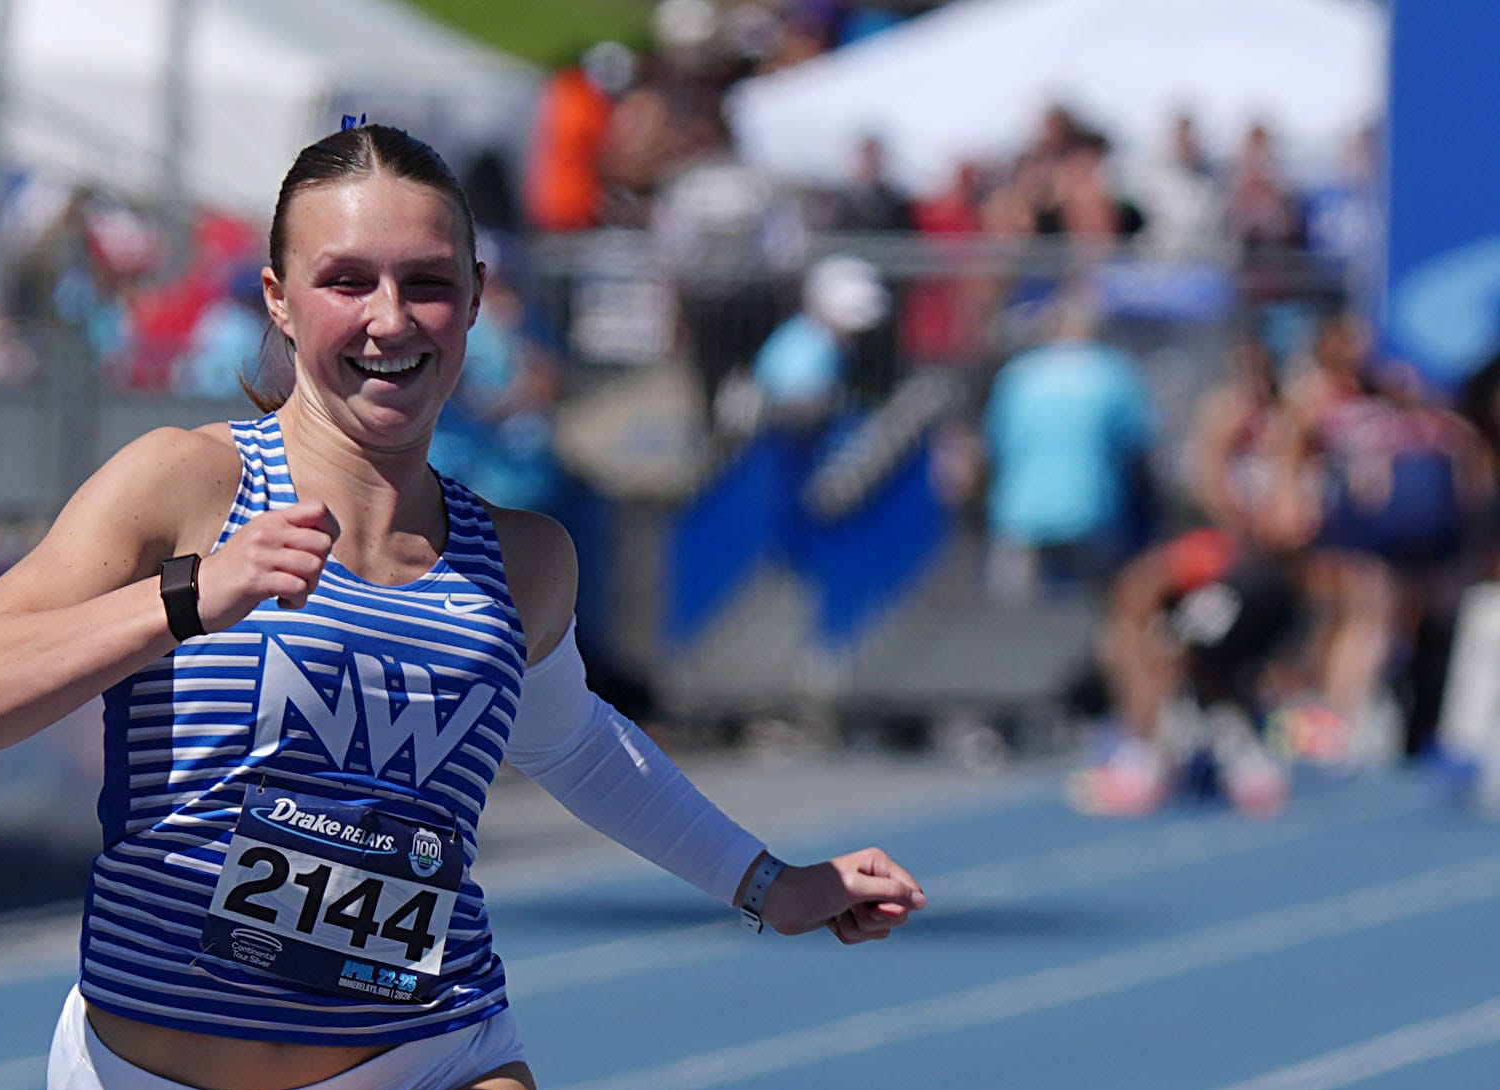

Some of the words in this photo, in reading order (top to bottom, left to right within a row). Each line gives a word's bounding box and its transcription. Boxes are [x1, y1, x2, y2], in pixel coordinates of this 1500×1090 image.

[251, 634, 499, 789] NW
[267, 797, 341, 837] Drake
[339, 825, 396, 852] RELAYS
[415, 838, 438, 859] 100
[222, 845, 438, 963] 2144
[231, 941, 276, 962] Continental
[232, 949, 250, 961] Tour
[248, 954, 271, 968] Silver
[340, 959, 374, 983] APRIL
[376, 967, 418, 993] 22-25
